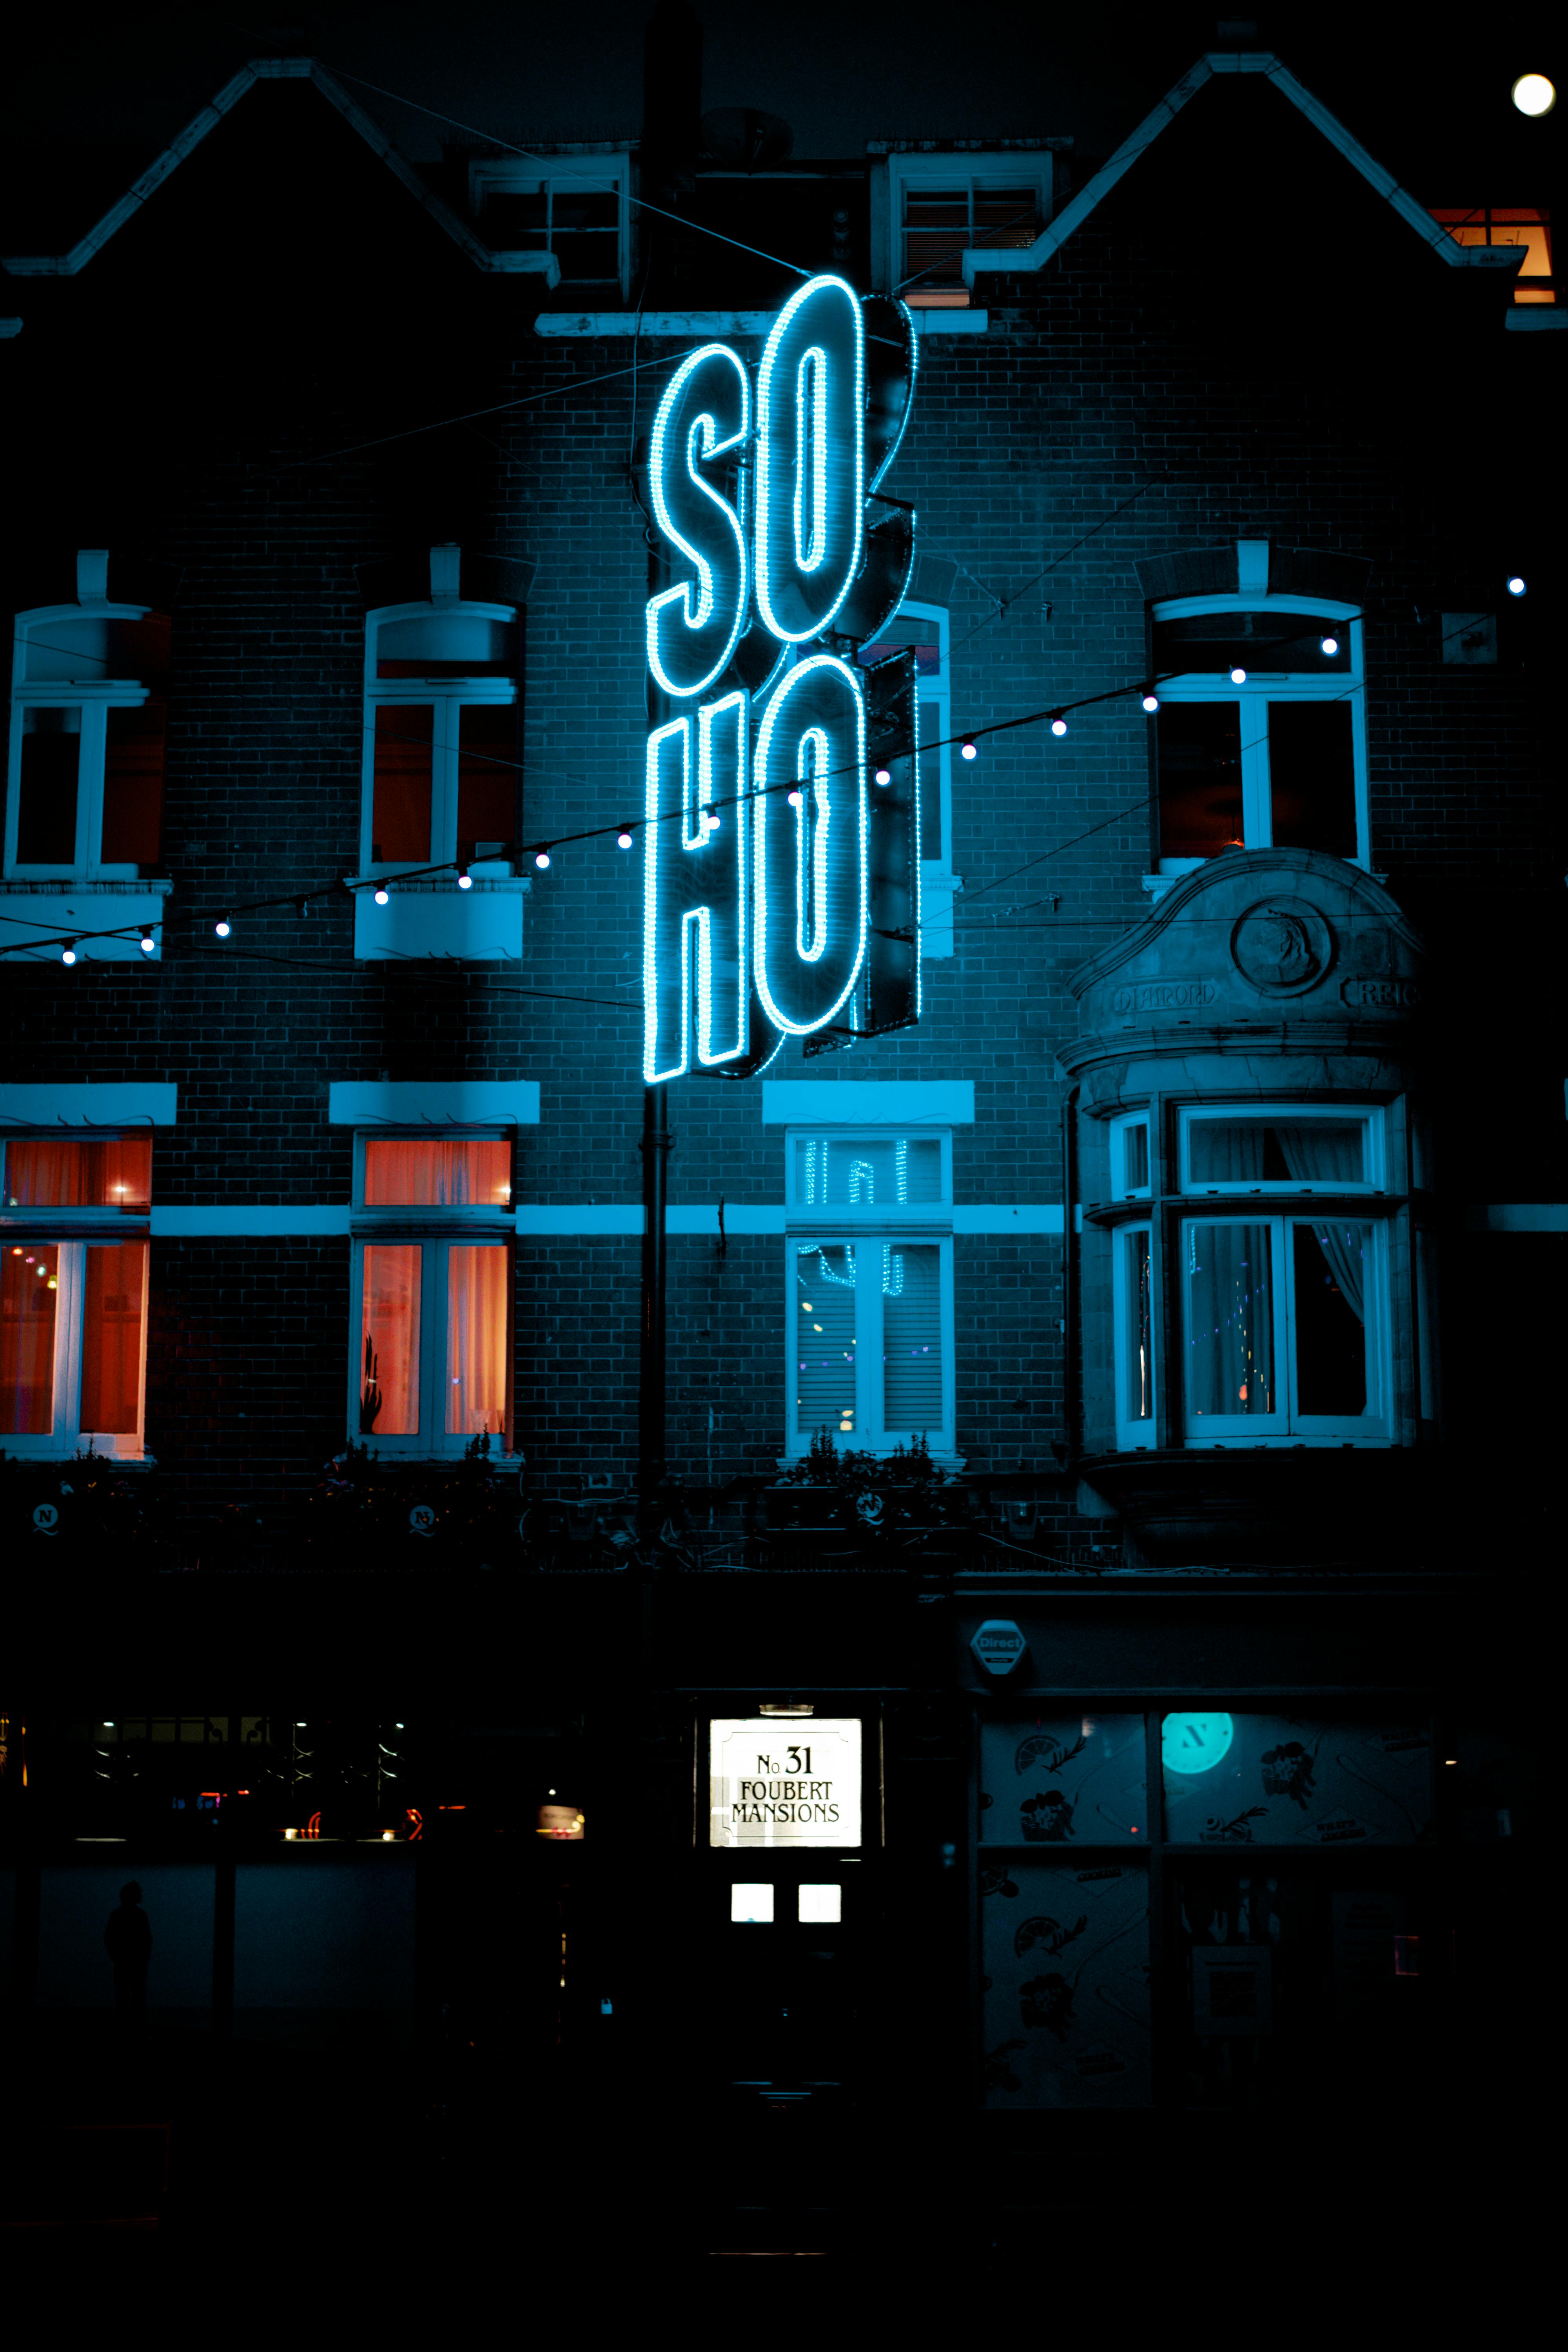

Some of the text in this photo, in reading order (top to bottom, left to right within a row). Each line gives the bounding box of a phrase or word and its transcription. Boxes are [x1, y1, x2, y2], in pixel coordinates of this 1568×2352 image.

[645, 273, 864, 698] SO
[644, 655, 869, 1083] HO
[980, 1637, 1020, 1648] Direct
[785, 1746, 814, 1774] 31
[740, 1781, 833, 1800] FOUBERT
[731, 1803, 840, 1822] MANSIONS
